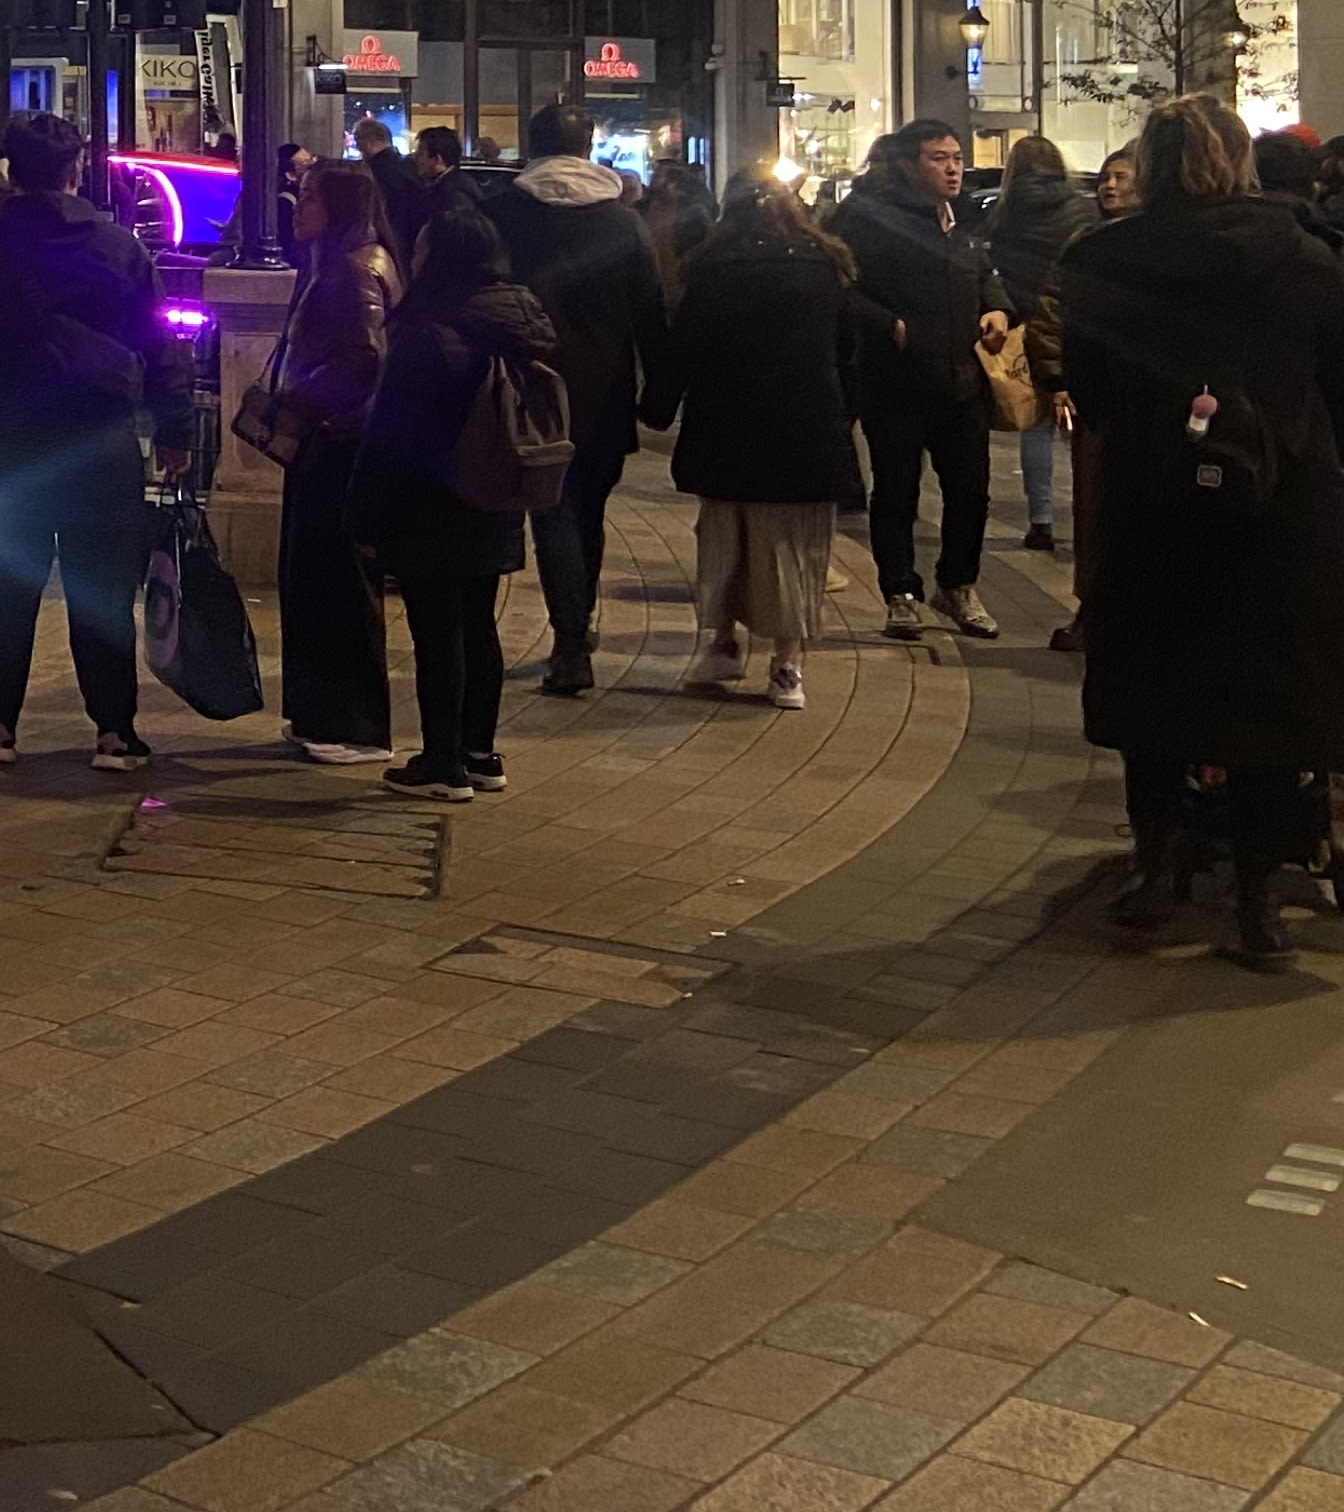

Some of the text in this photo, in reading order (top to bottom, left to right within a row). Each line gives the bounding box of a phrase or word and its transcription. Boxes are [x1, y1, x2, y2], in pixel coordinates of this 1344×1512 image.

[140, 59, 196, 79] KIKO
[343, 54, 401, 72] OMEGA
[584, 60, 640, 78] OMEGA
